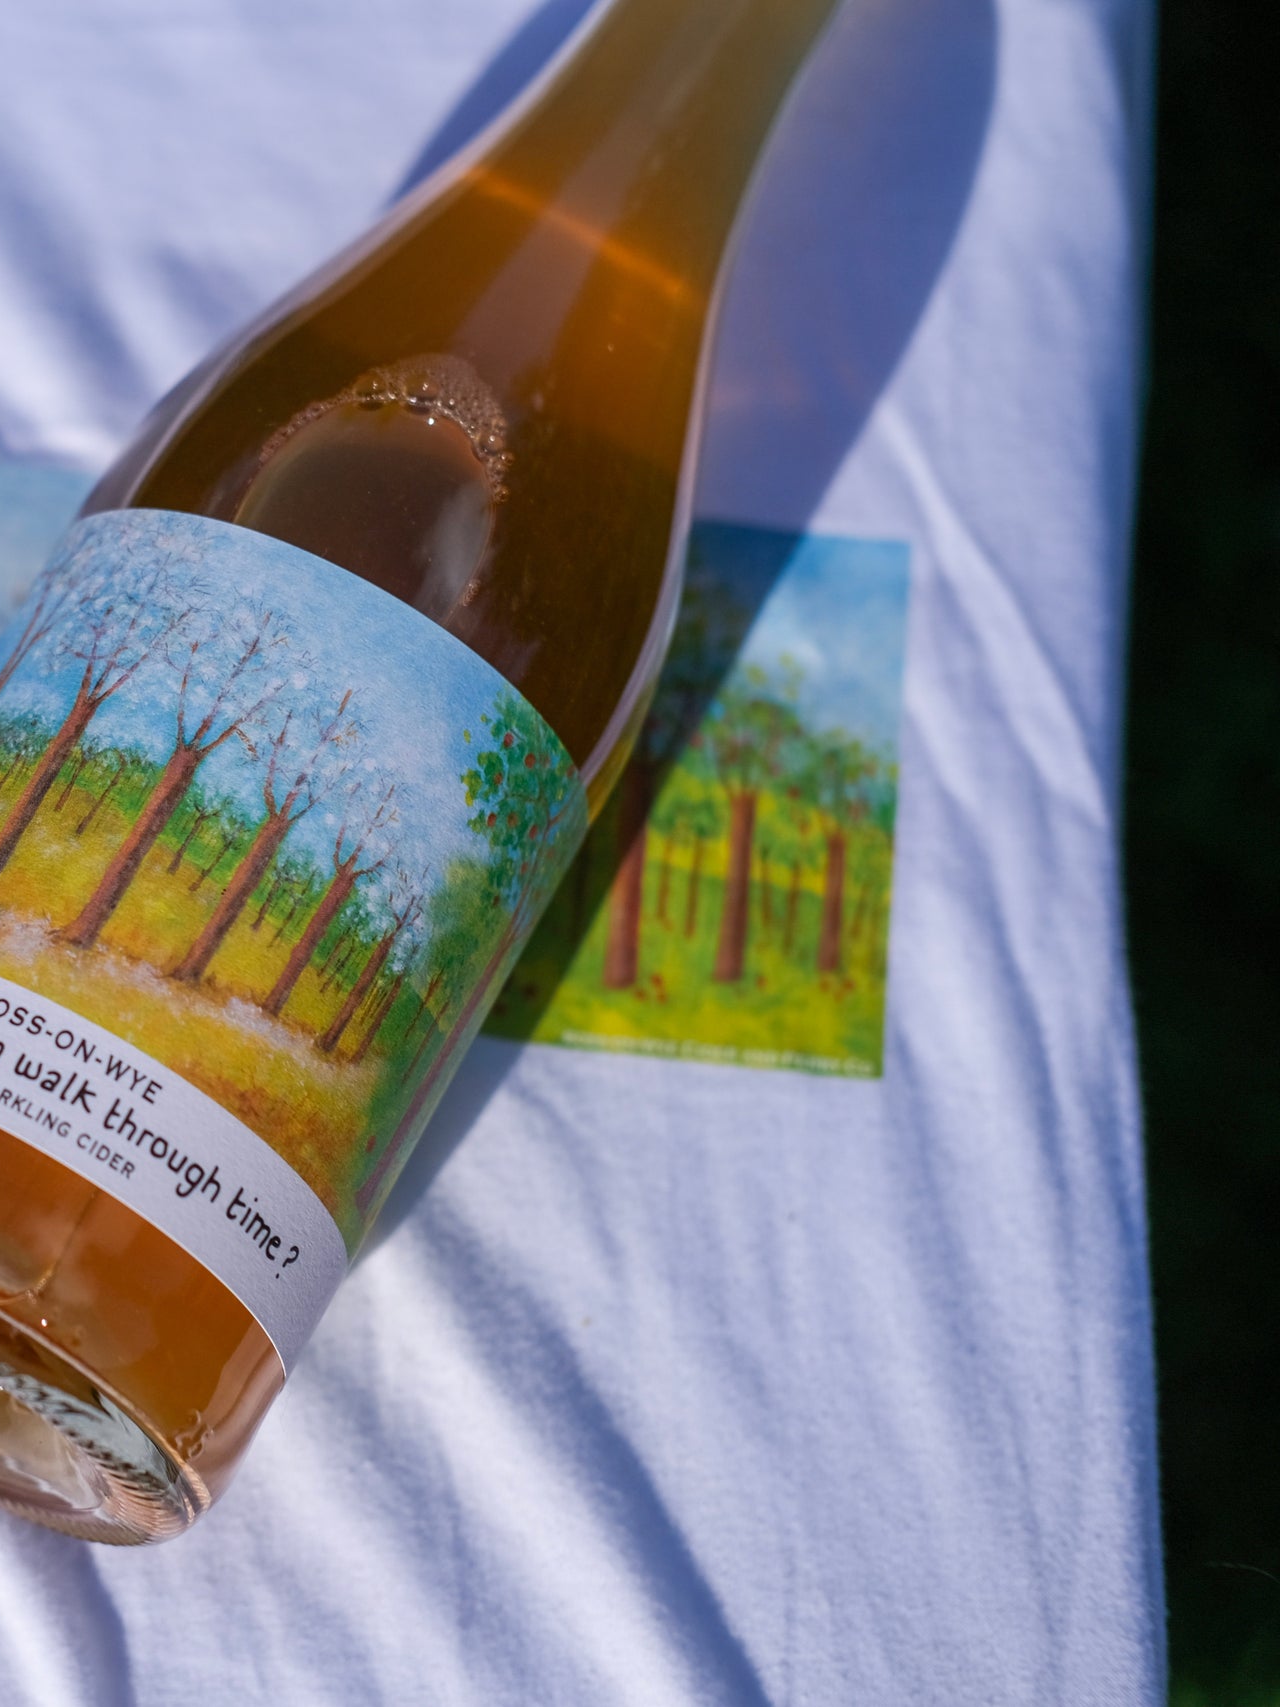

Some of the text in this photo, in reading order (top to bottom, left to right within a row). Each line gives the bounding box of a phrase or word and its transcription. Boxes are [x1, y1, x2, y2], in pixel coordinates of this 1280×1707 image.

[13, 1053, 97, 1114] walk
[103, 1098, 222, 1203] through
[225, 1187, 300, 1280] time?
[76, 1133, 136, 1179] CIDER
